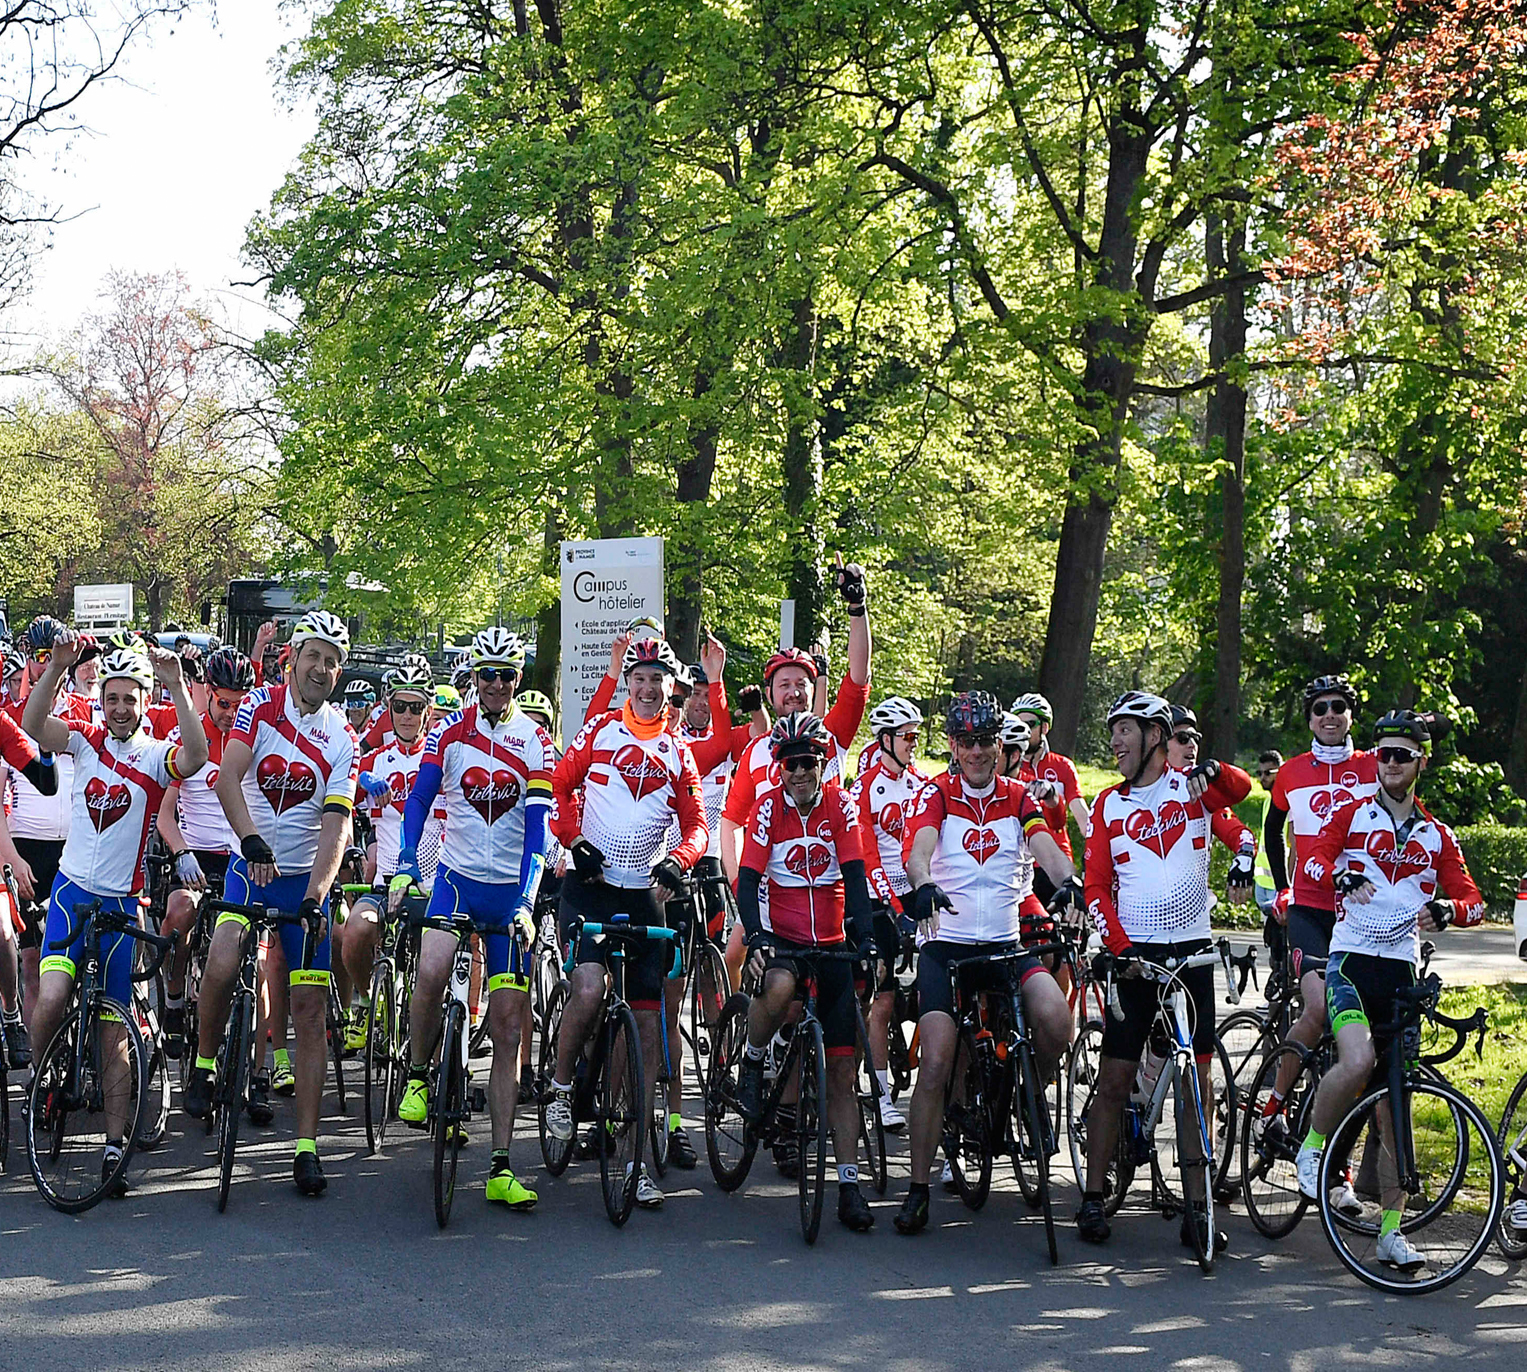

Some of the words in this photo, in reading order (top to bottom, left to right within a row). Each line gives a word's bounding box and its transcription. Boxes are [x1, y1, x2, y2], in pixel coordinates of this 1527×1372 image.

[573, 571, 628, 603] Campus
[599, 593, 646, 610] hôtelier
[581, 620, 599, 628] École
[581, 627, 608, 635] Château
[600, 641, 612, 649] Éco
[590, 649, 612, 657] Gestio
[581, 664, 599, 672] École
[581, 686, 596, 694] Écol
[260, 771, 313, 791] télévie
[468, 781, 519, 801] télévie
[752, 797, 774, 848] Lotto
[1088, 898, 1110, 937] Lotto
